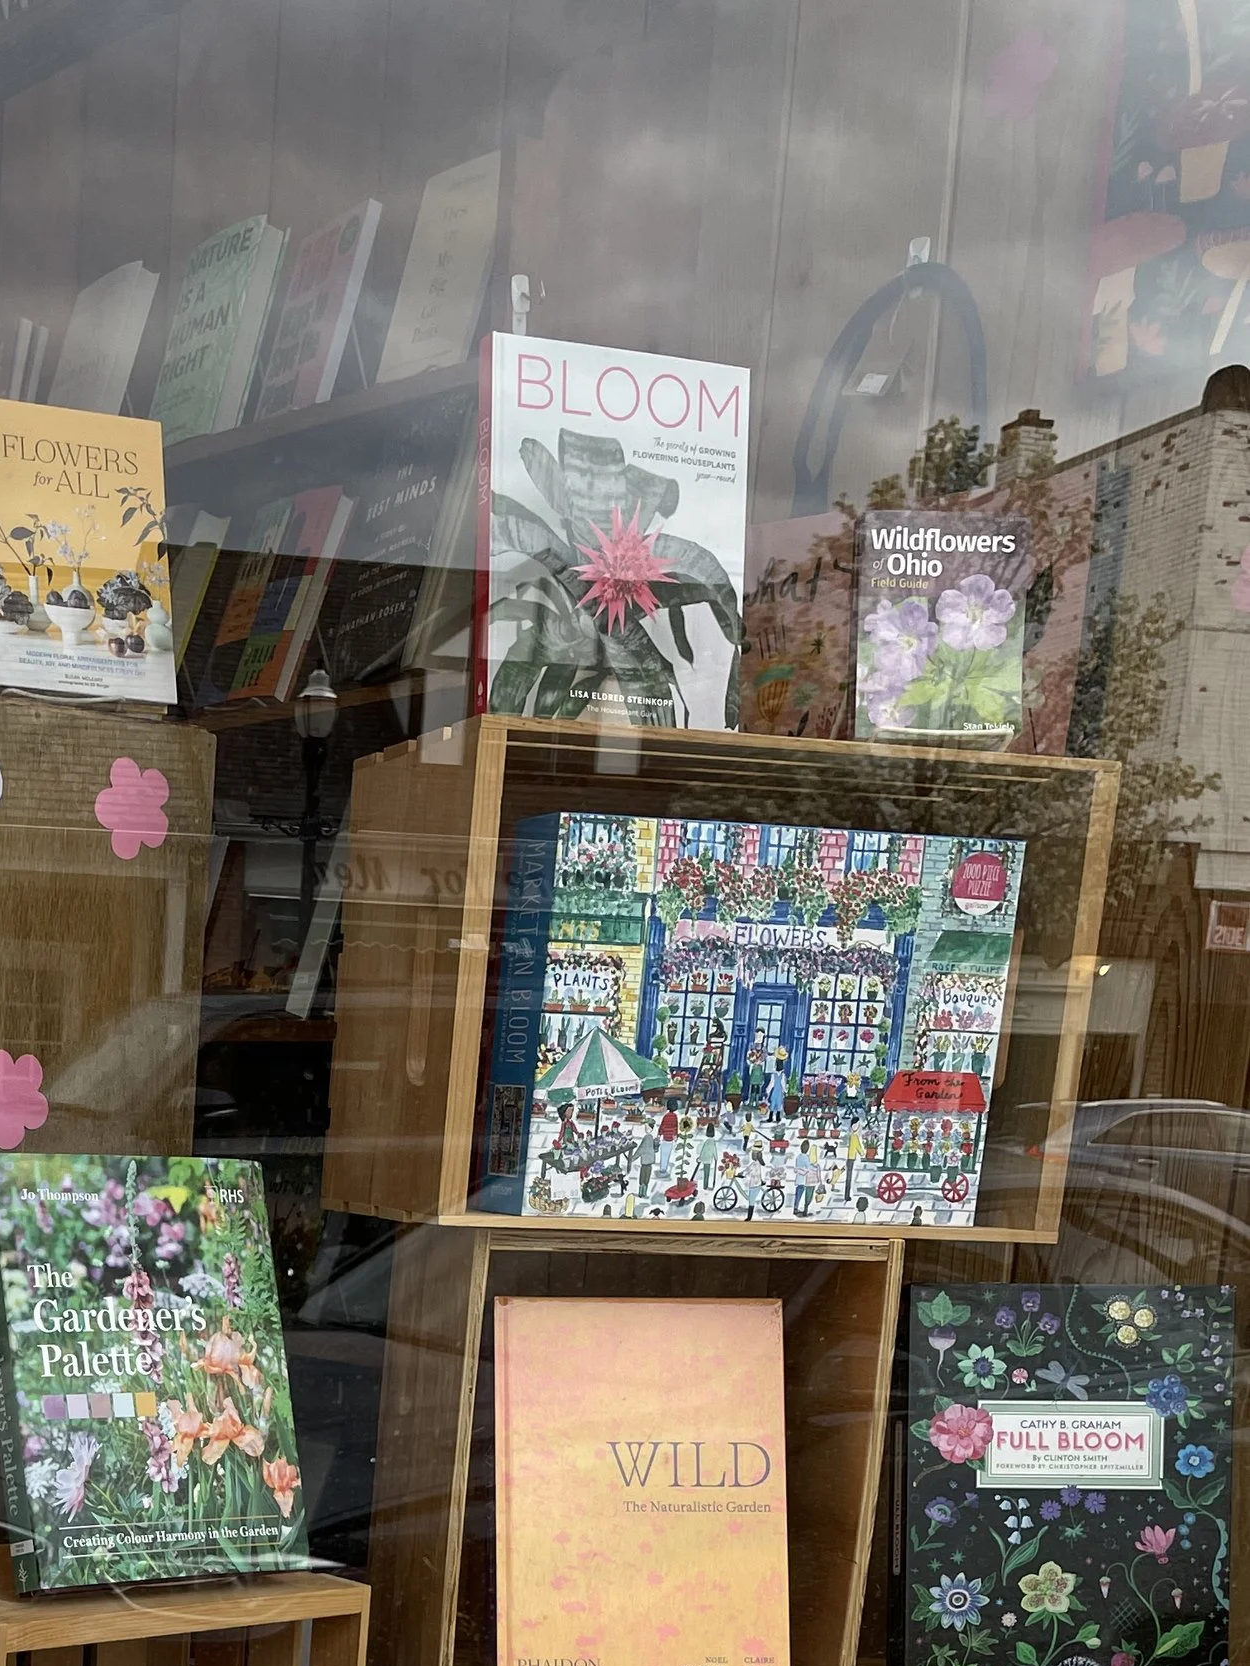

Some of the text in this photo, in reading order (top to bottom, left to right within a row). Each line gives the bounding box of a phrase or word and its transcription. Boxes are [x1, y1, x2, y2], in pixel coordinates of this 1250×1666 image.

[189, 227, 254, 277] NATURE
[169, 302, 231, 350] HUMAN
[159, 344, 210, 386] RIGHT
[518, 353, 740, 438] BLOOM
[2, 432, 139, 475] FLOWERS
[632, 450, 736, 471] FLOWERING HOUSEPLANTS
[33, 469, 110, 499] for ALL
[870, 525, 1016, 553] Wildflowers
[872, 552, 943, 577] of Ohio
[871, 577, 929, 590] Field Guide
[570, 689, 674, 707] LISA ELDRED STEINKOPF
[962, 863, 1000, 882] 1000 PIECE
[967, 881, 992, 898] PUZZLE
[734, 925, 828, 950] FLOWERS
[553, 972, 611, 992] PLANTS
[943, 987, 997, 1009] Bouquets
[903, 1072, 965, 1088] From the
[916, 1086, 964, 1101] Garden
[21, 1188, 99, 1204] Jo Thompson
[220, 1189, 244, 1204] RHS
[27, 1263, 73, 1289] The
[34, 1295, 207, 1334] Gardener's
[40, 1340, 154, 1379] Palette
[1020, 1419, 1122, 1430] CATHY B. GRAHAM
[996, 1431, 1145, 1451] FULL BLOOM
[606, 1441, 771, 1488] WILD
[1032, 1454, 1108, 1463] By CLINTON SMITH
[623, 1501, 772, 1513] The Naturalistic Garden
[63, 1524, 279, 1550] Creating Colour Harmony in the Garden
[705, 1656, 728, 1664] NOEL
[744, 1656, 775, 1664] CLAIRE
